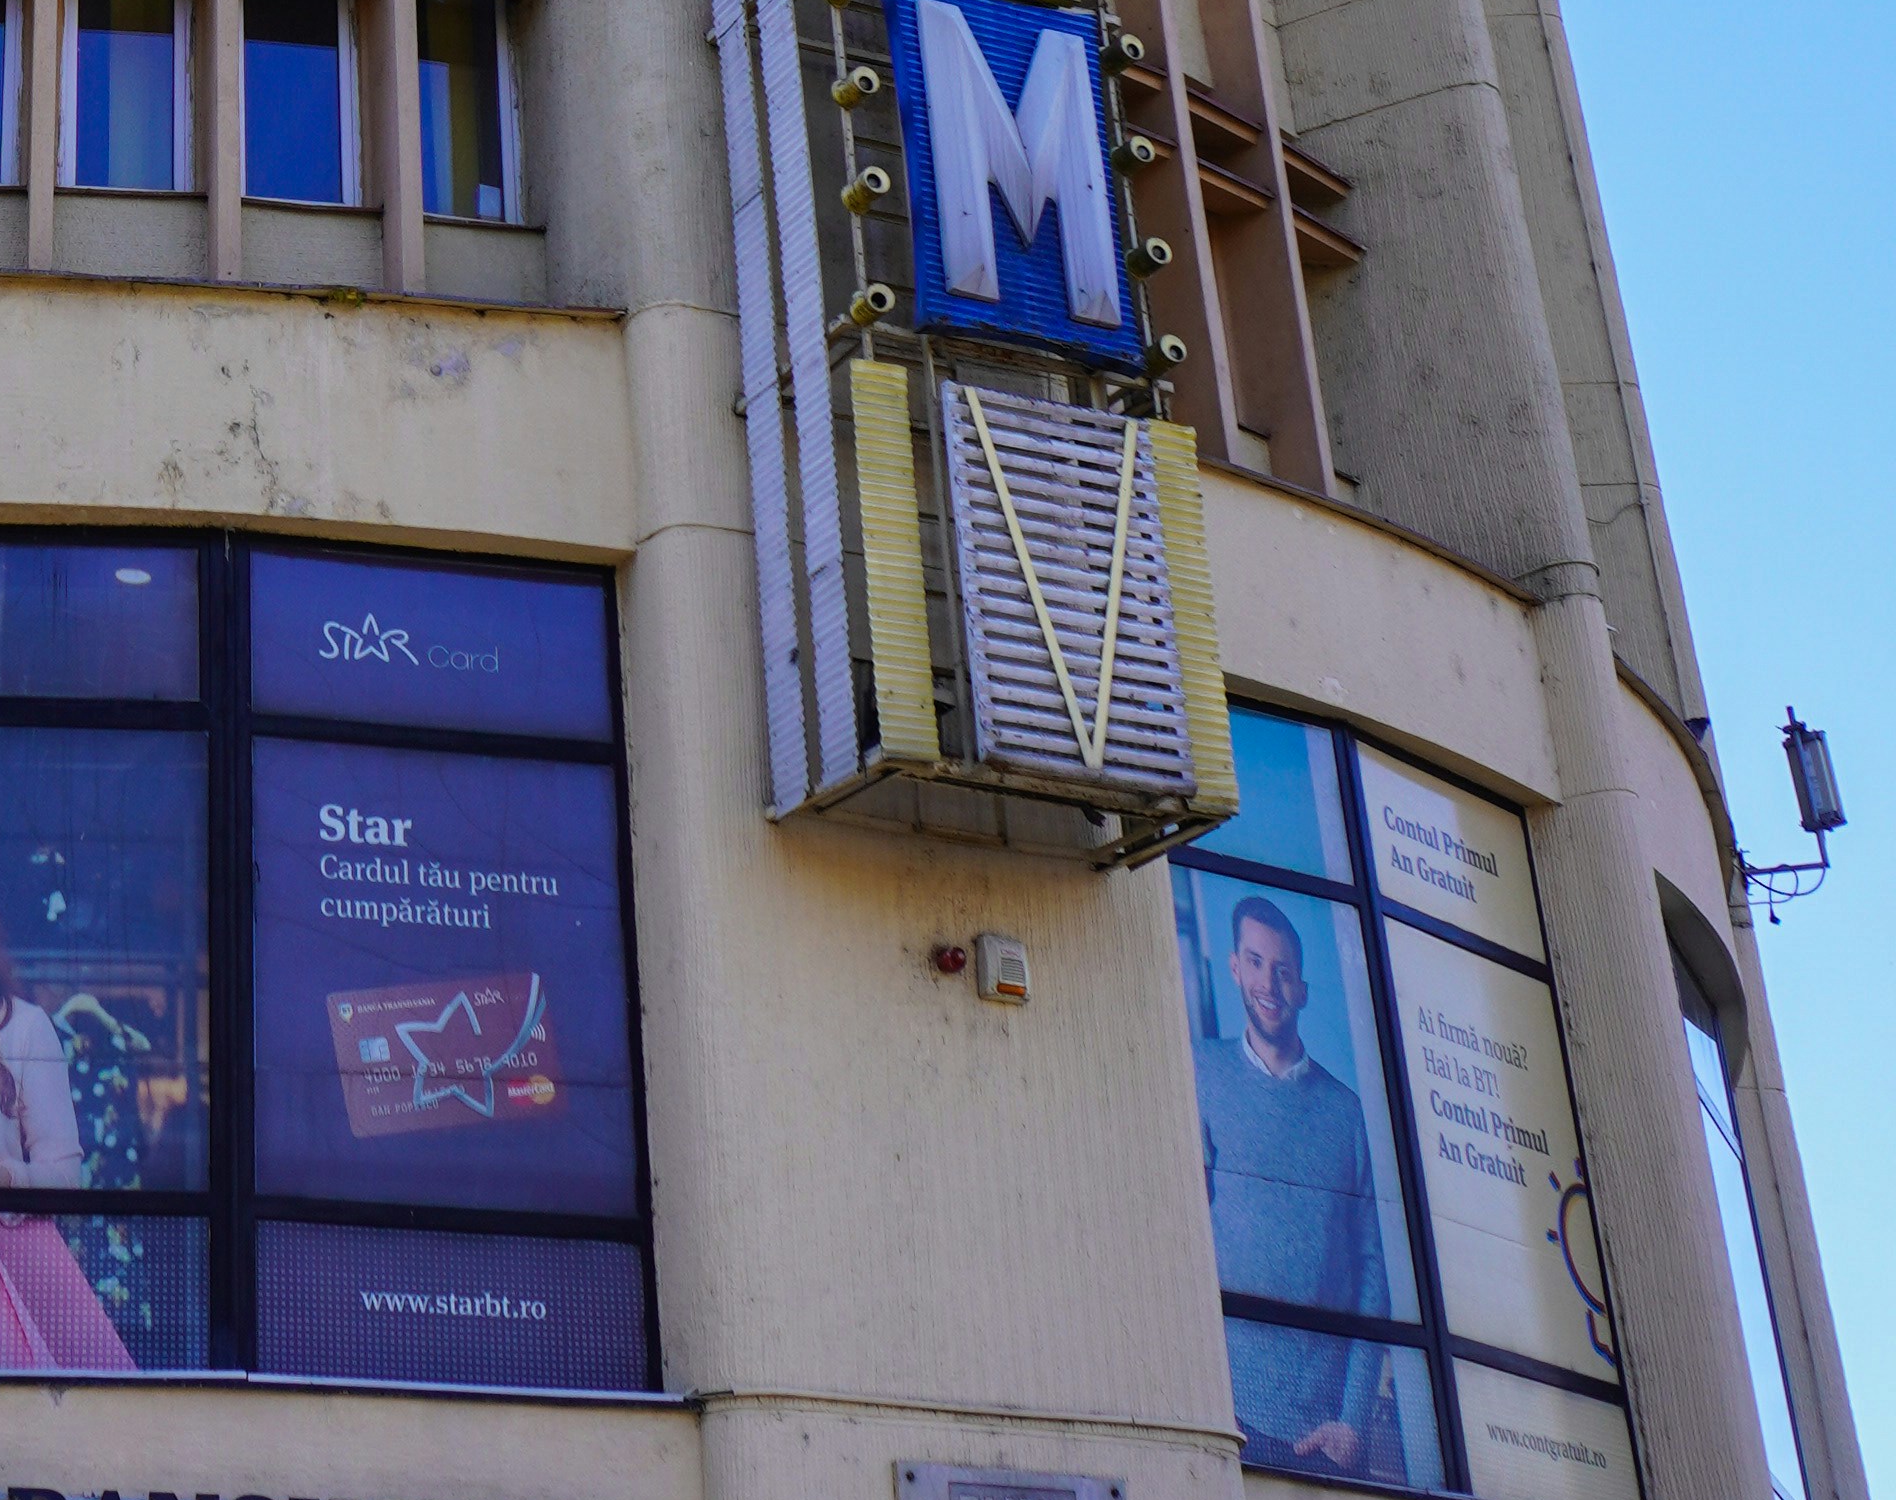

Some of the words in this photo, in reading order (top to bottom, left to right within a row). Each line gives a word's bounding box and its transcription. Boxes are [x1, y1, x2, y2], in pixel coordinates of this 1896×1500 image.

[427, 645, 500, 674] Card
[317, 802, 413, 847] Star
[1383, 805, 1441, 852] Contul
[1441, 837, 1499, 878] Primul
[319, 853, 411, 885] Cardul
[417, 861, 462, 889] tău
[469, 868, 560, 897] pentru
[1391, 844, 1415, 876] An
[1416, 856, 1478, 904] Gratuit
[319, 895, 492, 930] cumpărături
[1418, 1006, 1436, 1036] Ai
[1438, 1013, 1481, 1052] firmă
[1481, 1036, 1528, 1071] nouă?
[1422, 1046, 1452, 1082] Hai
[1453, 1058, 1471, 1088] la
[1472, 1064, 1501, 1099] BT!
[1430, 1089, 1489, 1134] Contul
[1489, 1111, 1550, 1156] Primul
[1438, 1132, 1463, 1165] An
[1465, 1142, 1528, 1187] Gratuit
[360, 1289, 547, 1321] www.starbt.ro
[1485, 1423, 1607, 1469] www.contgratuit.ro
